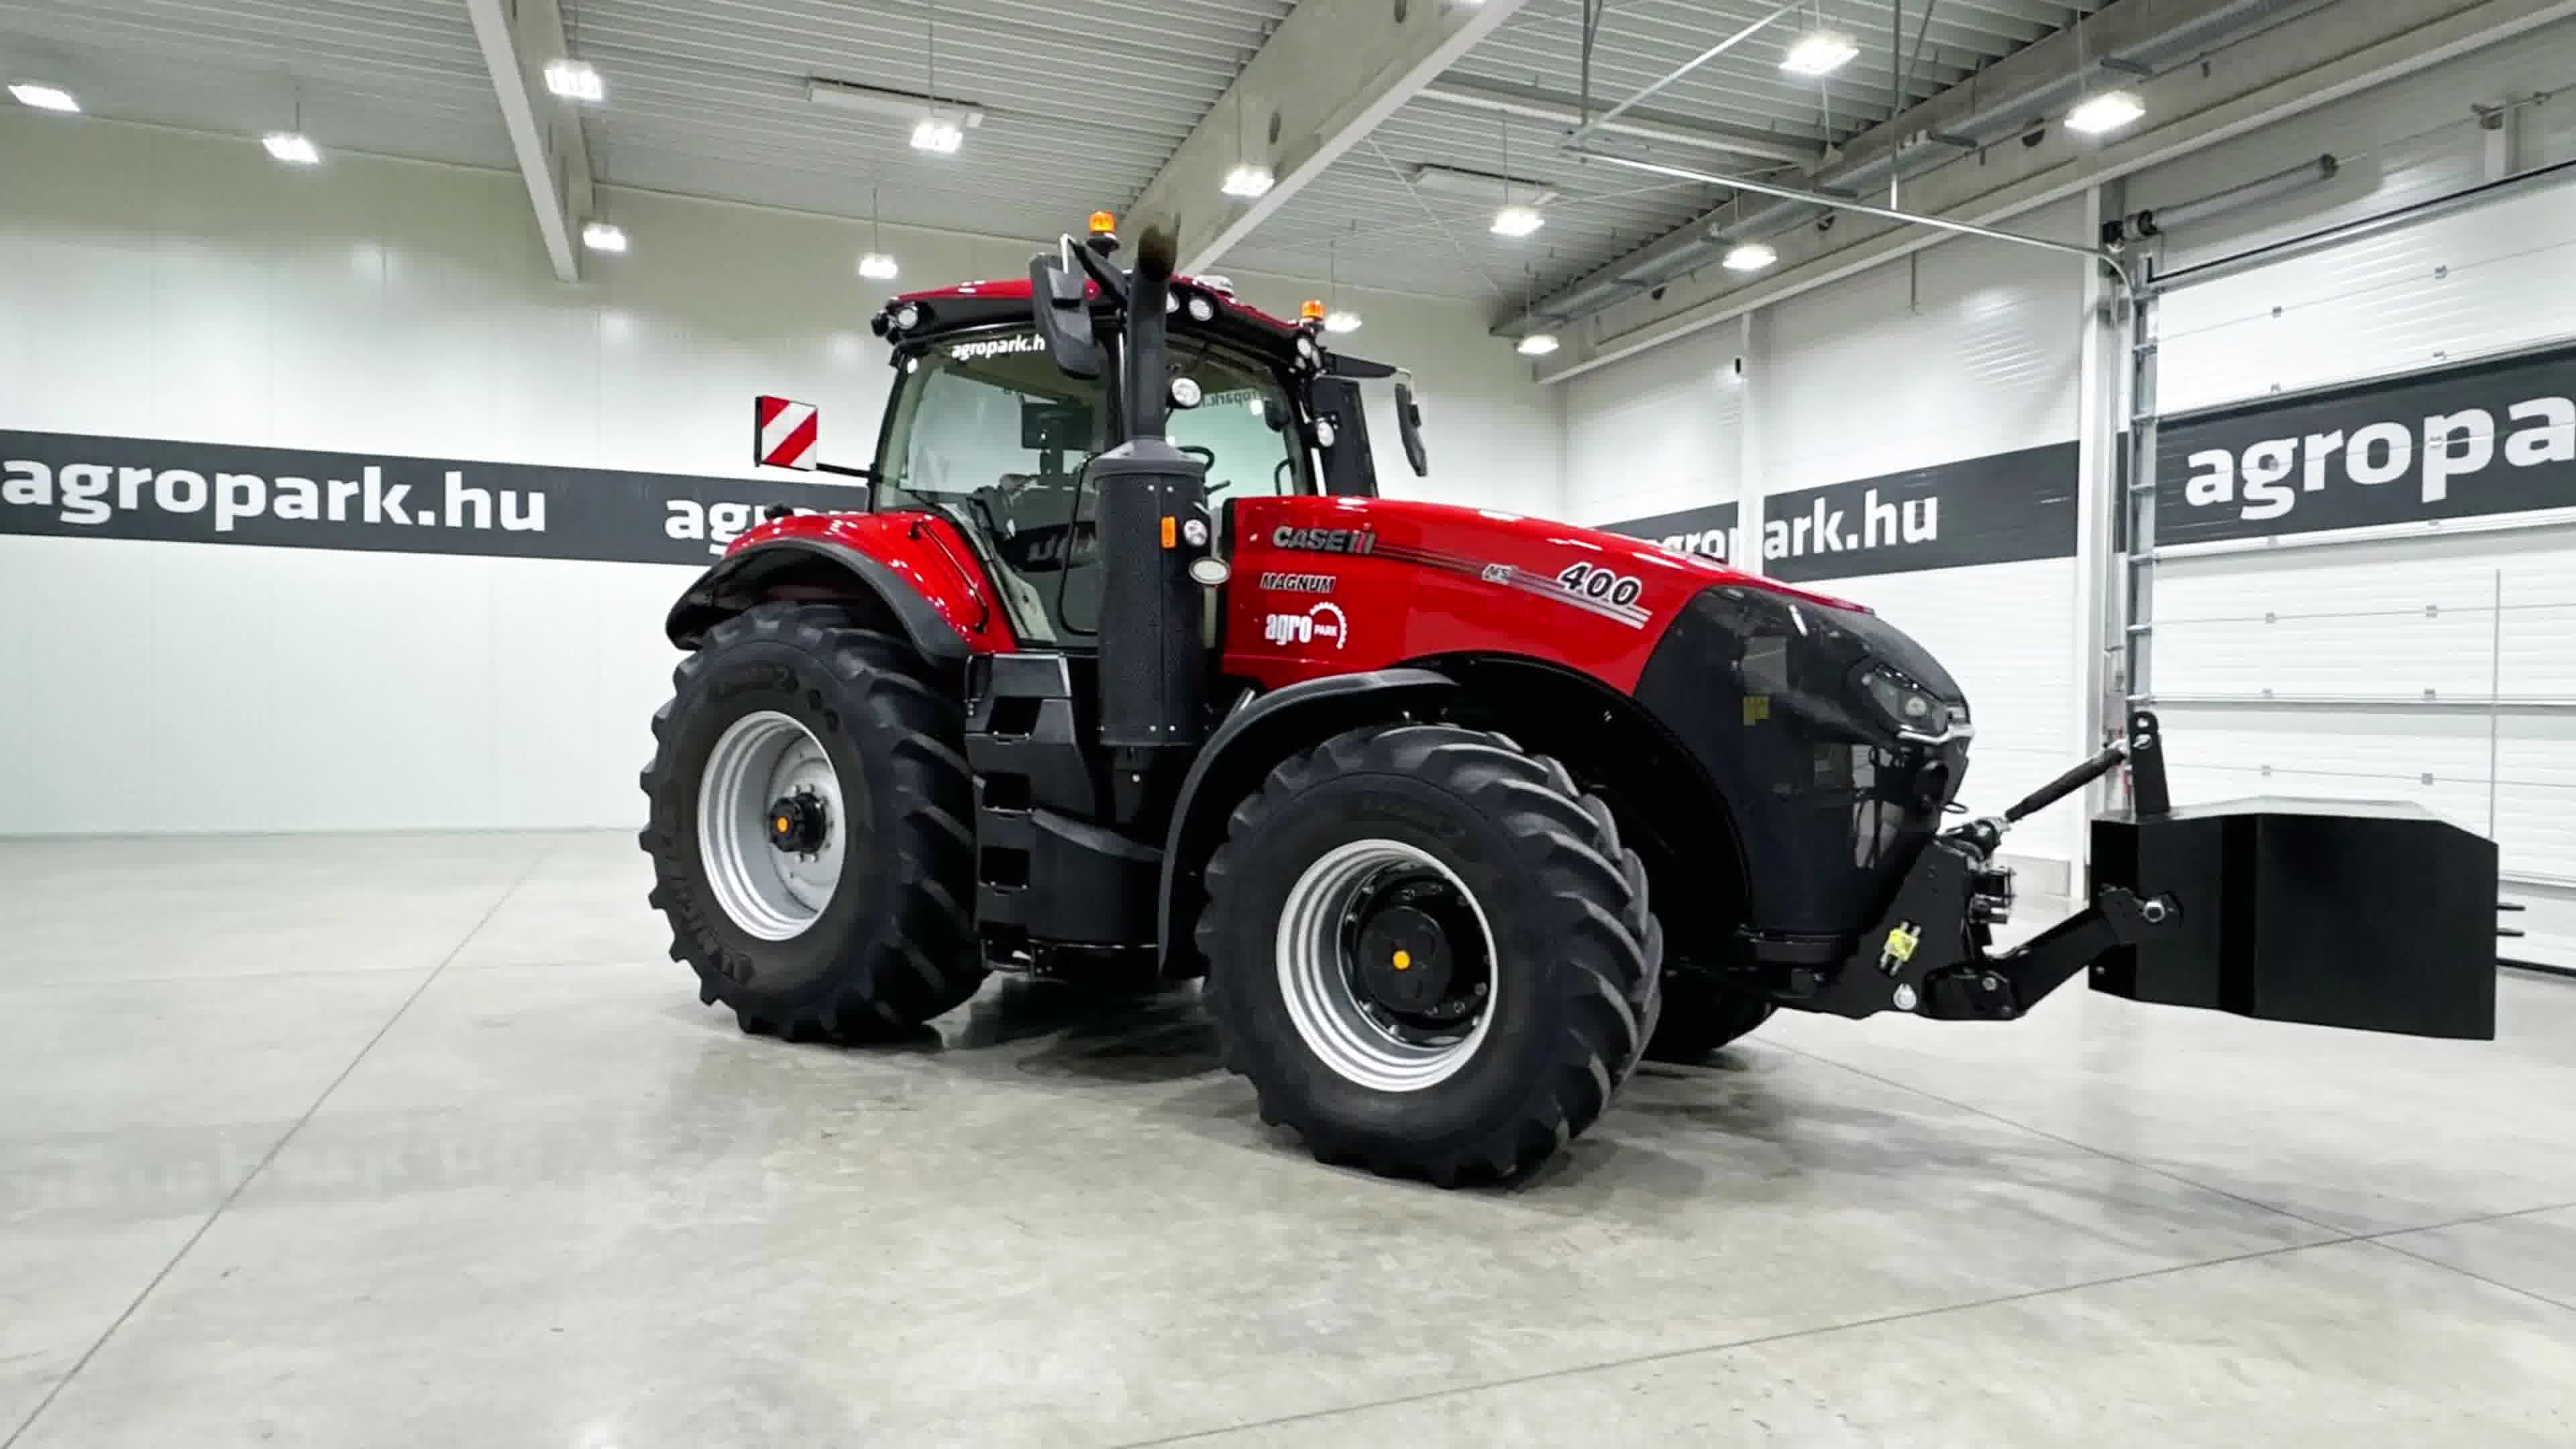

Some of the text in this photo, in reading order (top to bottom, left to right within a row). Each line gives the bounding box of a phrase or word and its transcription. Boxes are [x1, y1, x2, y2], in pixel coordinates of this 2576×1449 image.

[952, 333, 1046, 361] agropark.h
[2185, 396, 2576, 521] agropa
[1, 459, 546, 531] agropark.hu
[1273, 526, 1348, 552] CASE
[1260, 572, 1337, 594] MAGNUM
[1557, 562, 1642, 606] 400
[1265, 614, 1313, 645] agro
